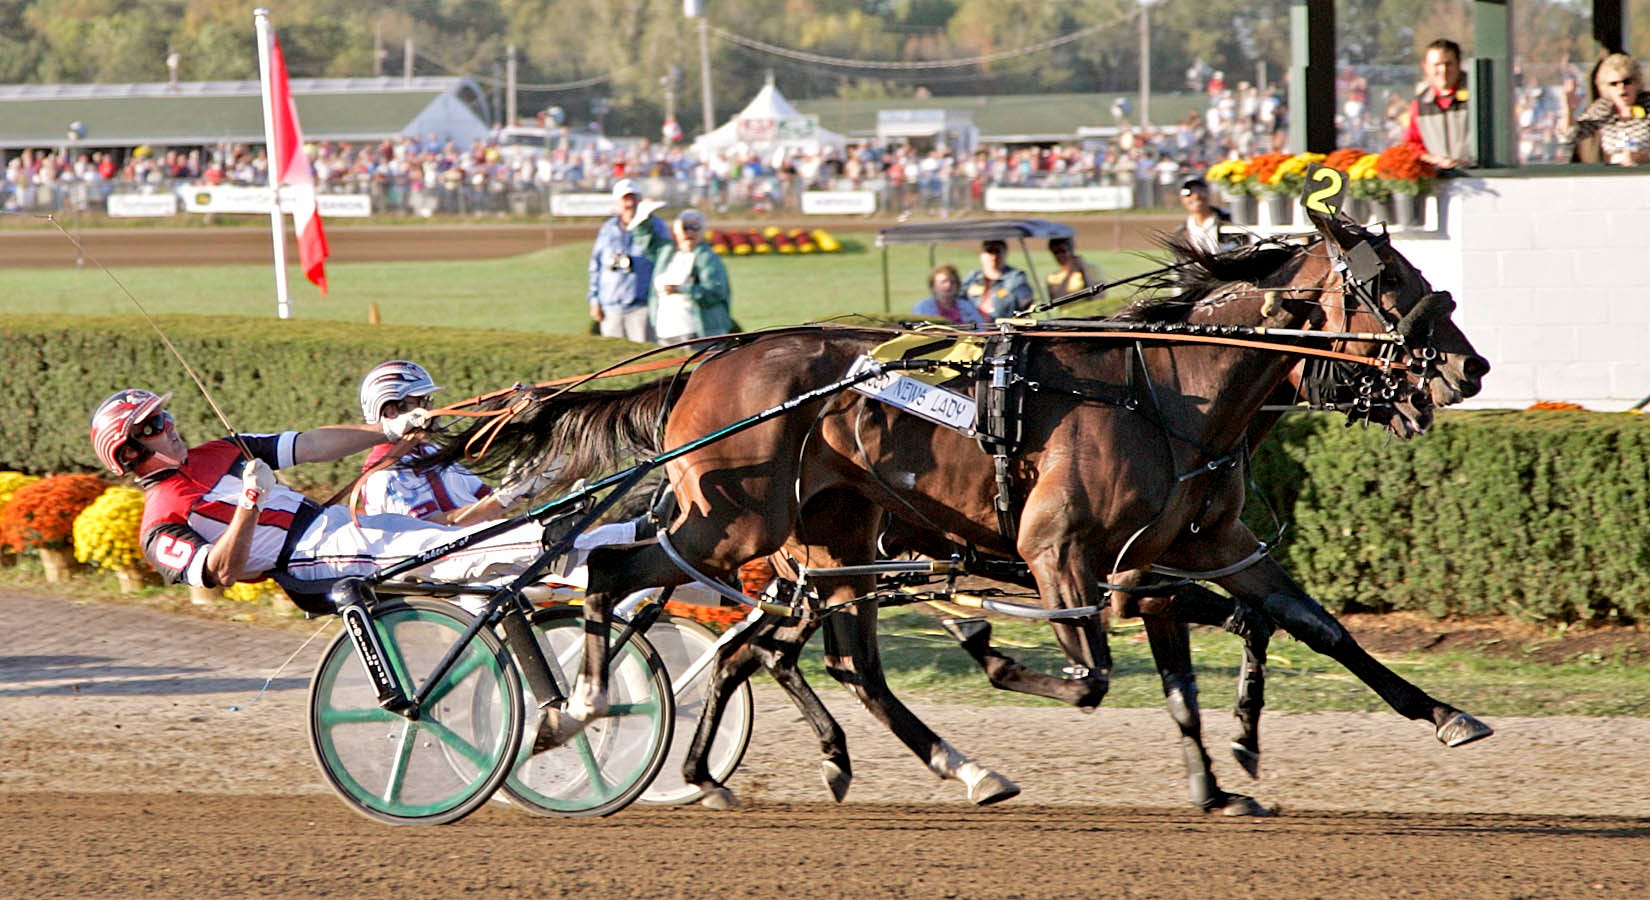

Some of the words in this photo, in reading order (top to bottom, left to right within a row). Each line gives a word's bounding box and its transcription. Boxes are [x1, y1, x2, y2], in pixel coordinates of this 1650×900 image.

[1306, 167, 1342, 214] 2
[893, 381, 926, 407] NEWS
[930, 393, 966, 419] LADY
